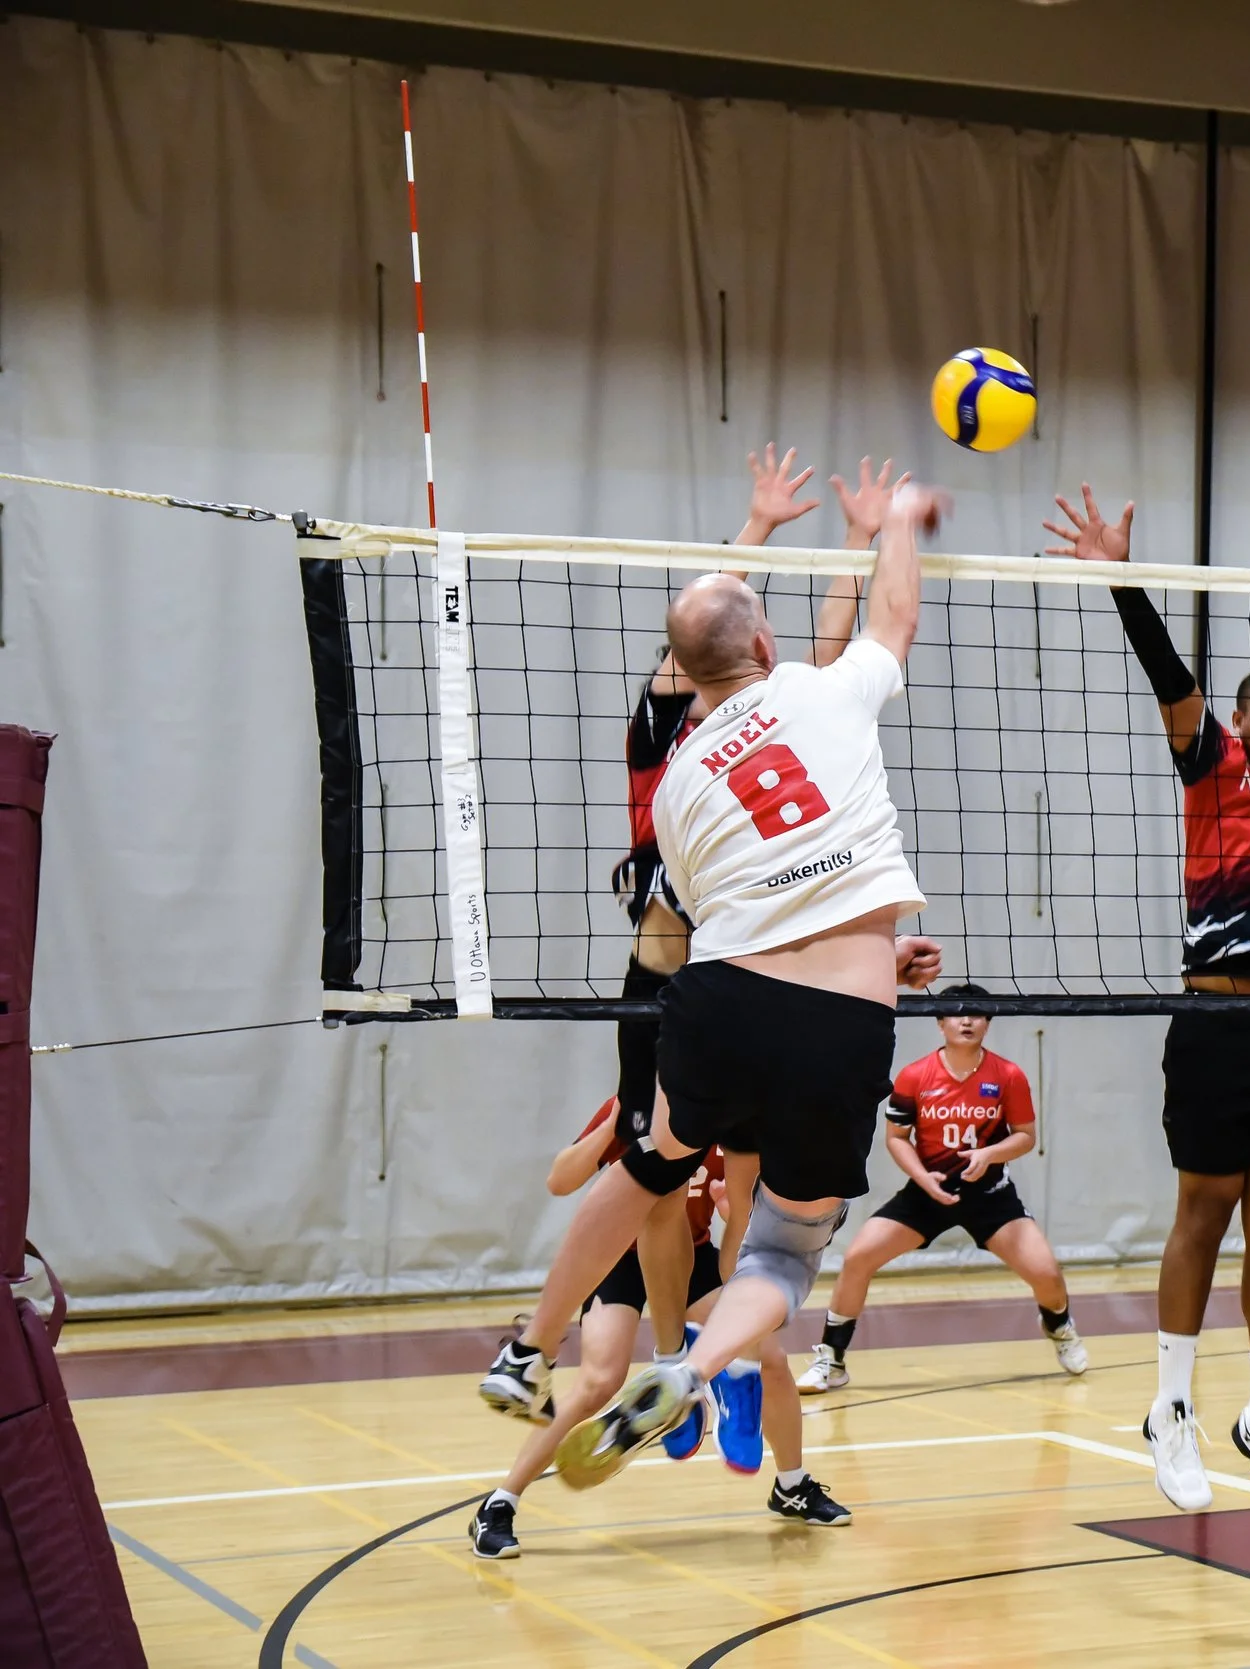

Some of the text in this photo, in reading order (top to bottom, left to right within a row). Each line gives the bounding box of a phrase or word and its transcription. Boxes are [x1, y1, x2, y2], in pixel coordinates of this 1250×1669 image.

[700, 711, 779, 777] NOEL
[727, 743, 831, 841] 8
[920, 1101, 1002, 1120] Montreal
[942, 1123, 978, 1149] 04
